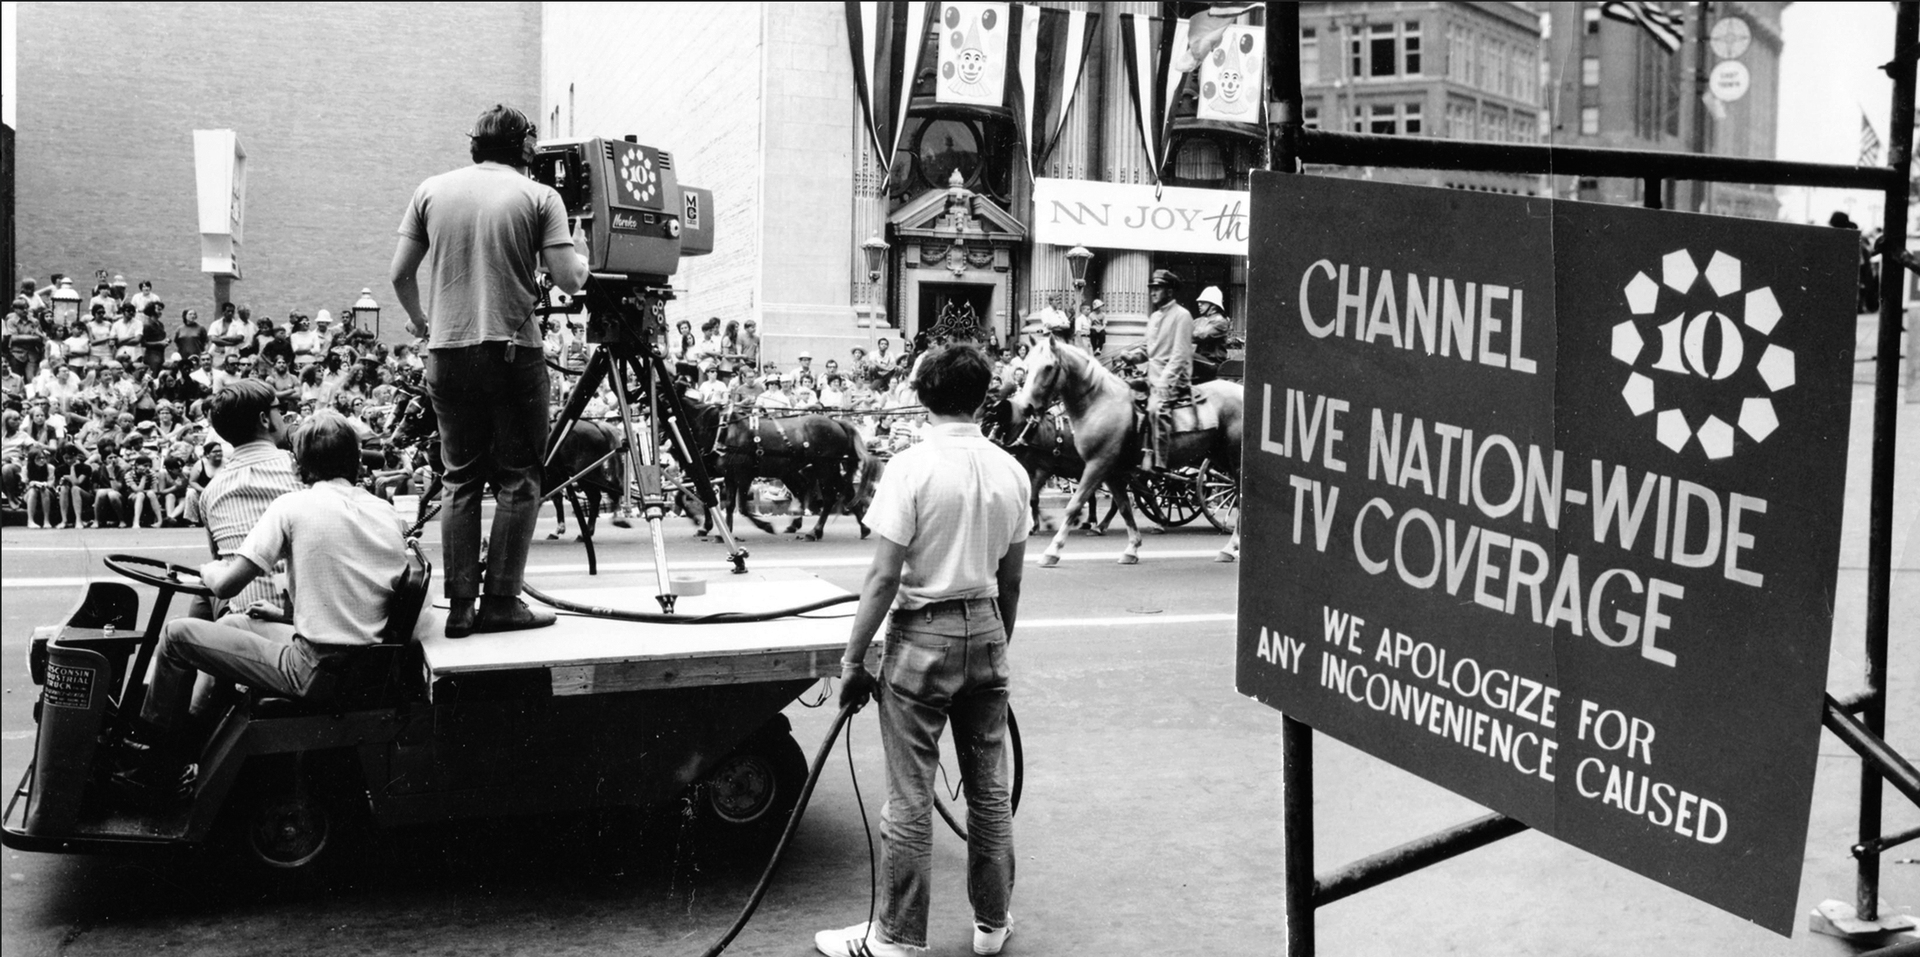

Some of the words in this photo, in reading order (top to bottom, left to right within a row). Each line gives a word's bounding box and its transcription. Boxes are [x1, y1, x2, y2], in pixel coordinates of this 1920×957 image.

[629, 165, 648, 185] 10
[1124, 206, 1203, 232] JOY
[1202, 200, 1249, 242] th
[1299, 259, 1538, 375] CHANNEL
[1651, 310, 1744, 381] 10
[1260, 383, 1350, 473] LIVE
[1368, 408, 1768, 588] NATION-WIDE
[1289, 474, 1340, 553] TV
[1353, 497, 1685, 668] COVERAGE
[46, 678, 72, 690] TRUCK
[1256, 625, 1307, 675] ANY
[1320, 650, 1559, 783] INCONVENIENCE
[1575, 757, 1728, 845] CAUSED
[1323, 605, 1366, 655] WE
[1375, 627, 1561, 729] APOLOGIZE
[1577, 698, 1656, 766] FOR
